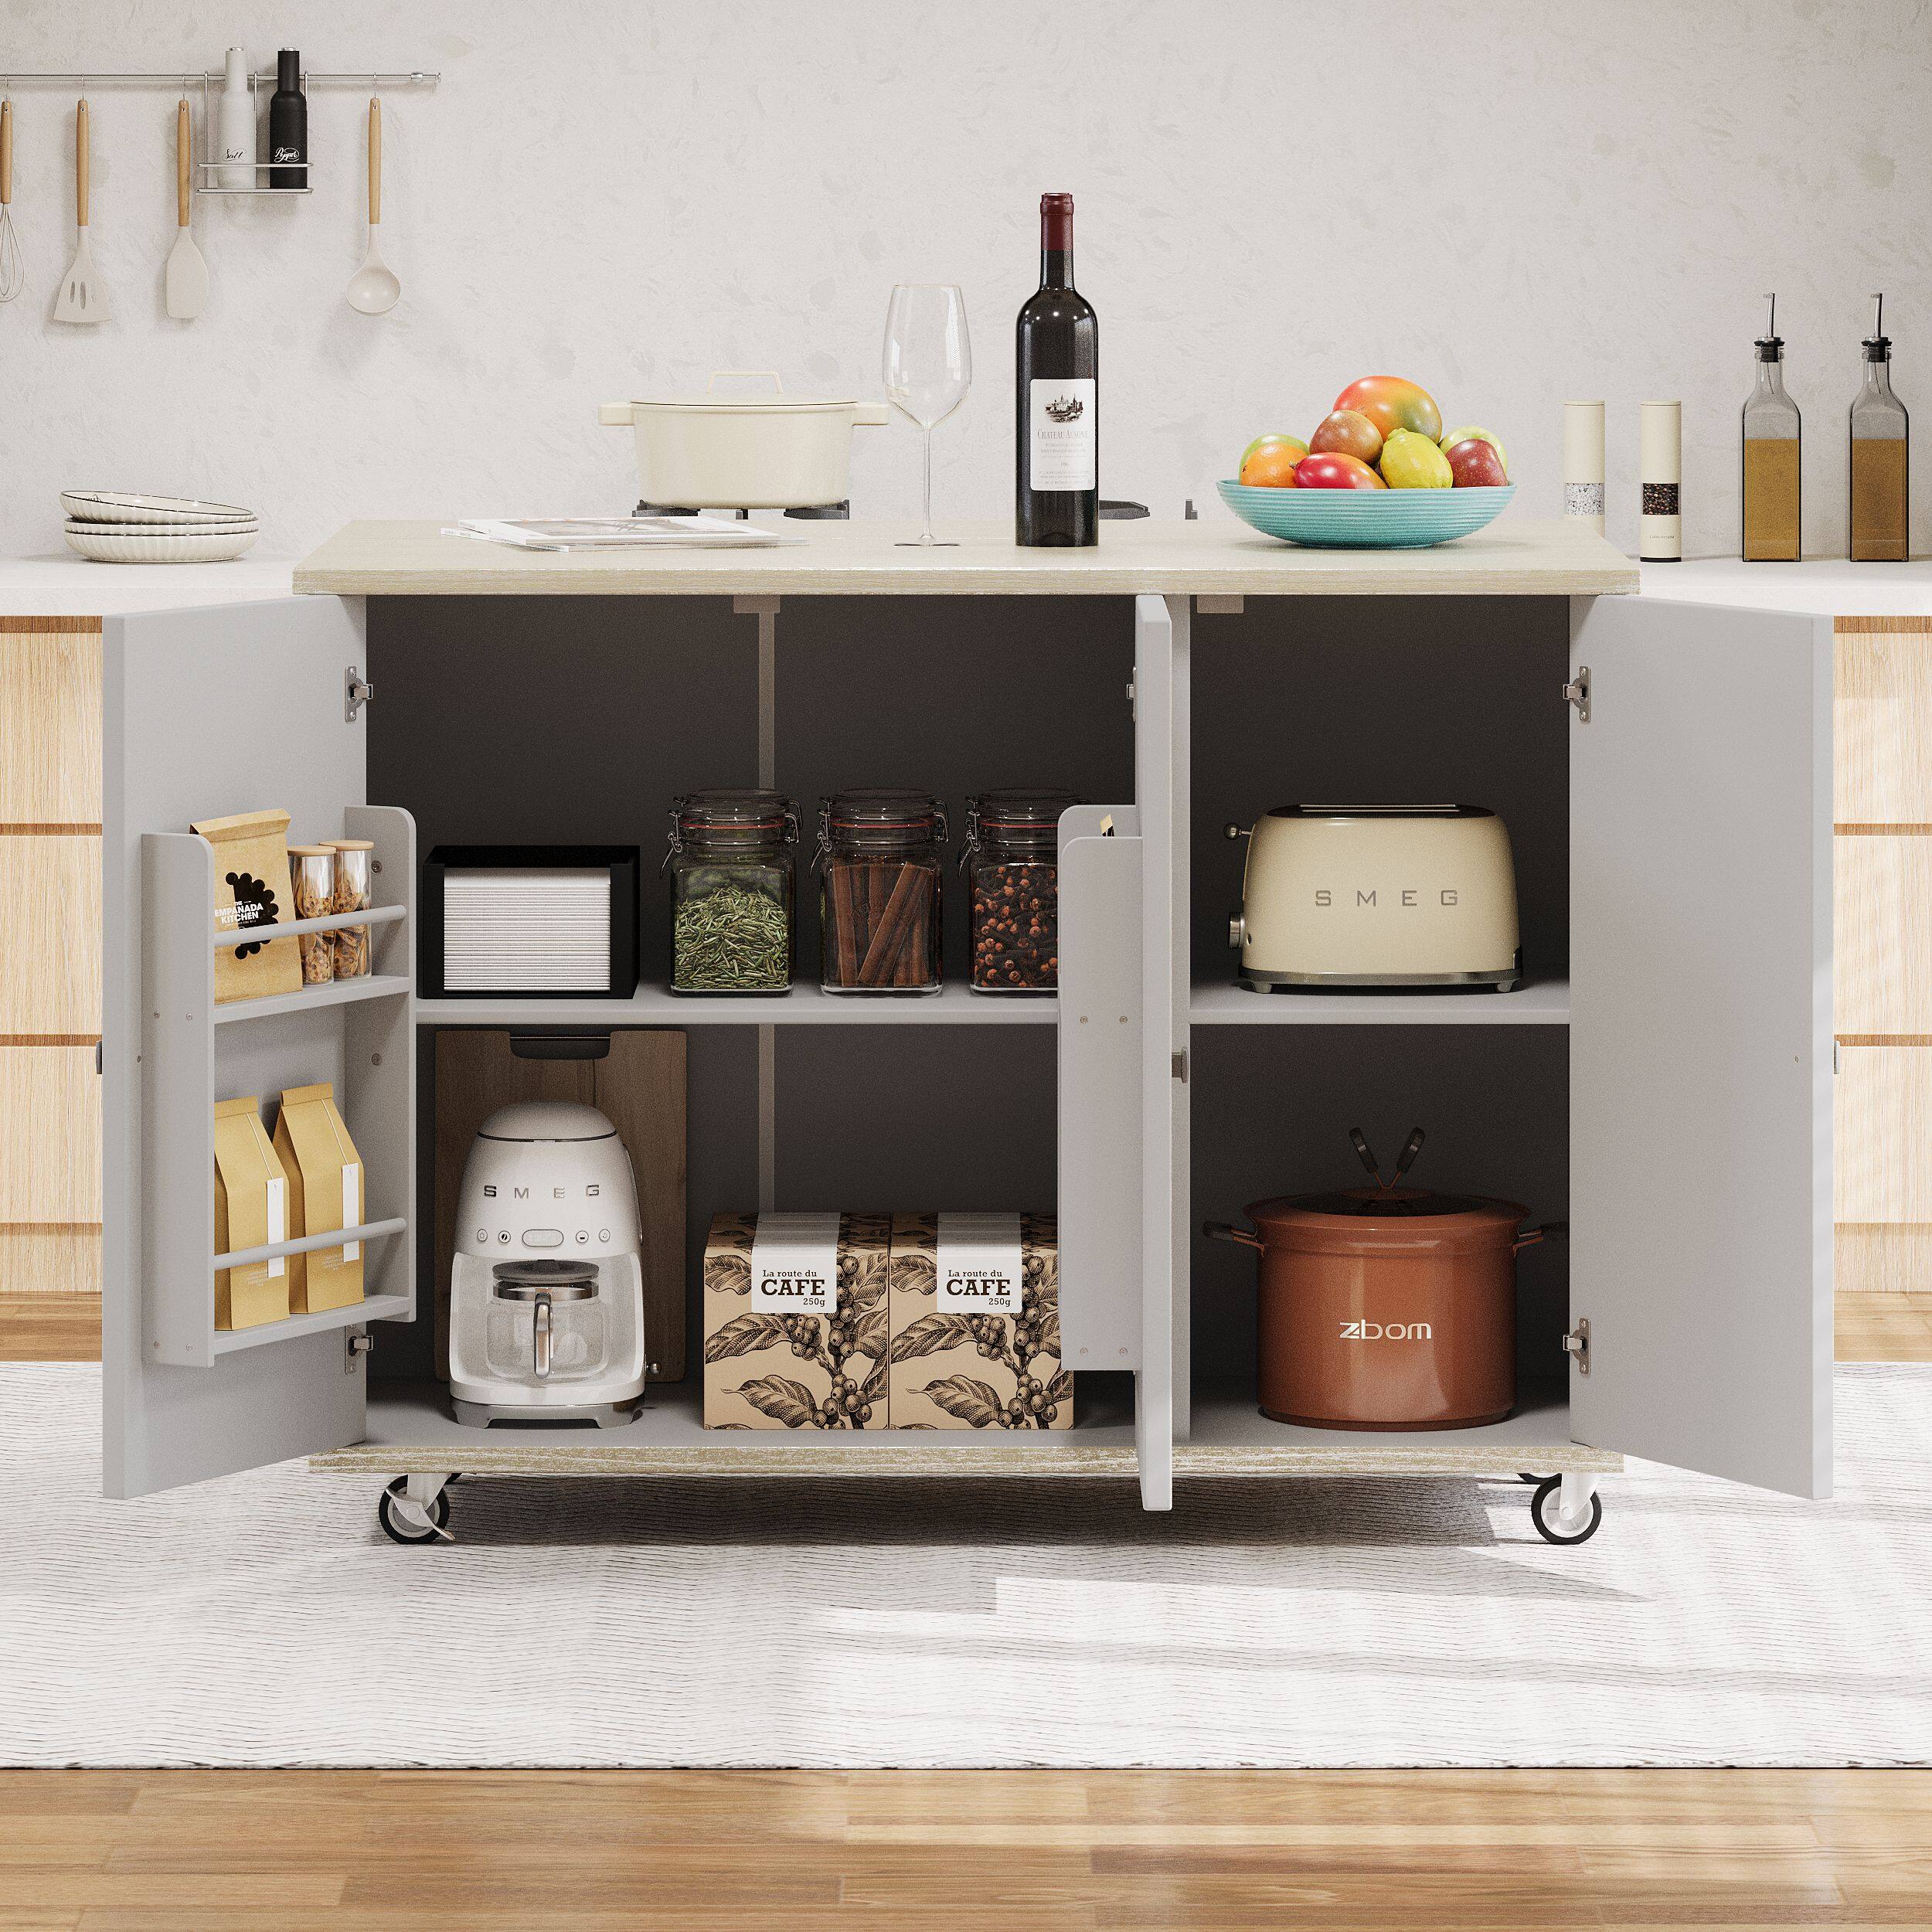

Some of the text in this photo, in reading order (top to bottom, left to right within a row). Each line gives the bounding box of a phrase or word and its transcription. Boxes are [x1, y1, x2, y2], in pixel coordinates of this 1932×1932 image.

[1315, 889, 1458, 907] SMEG
[215, 903, 264, 917] EMPANADA
[222, 911, 259, 924] KITCHEN
[484, 1184, 600, 1199] SMEG
[761, 1279, 825, 1295] CAFE
[947, 1279, 1011, 1295] CAFE
[804, 1298, 825, 1307] 250g
[989, 1298, 1011, 1307] 250g
